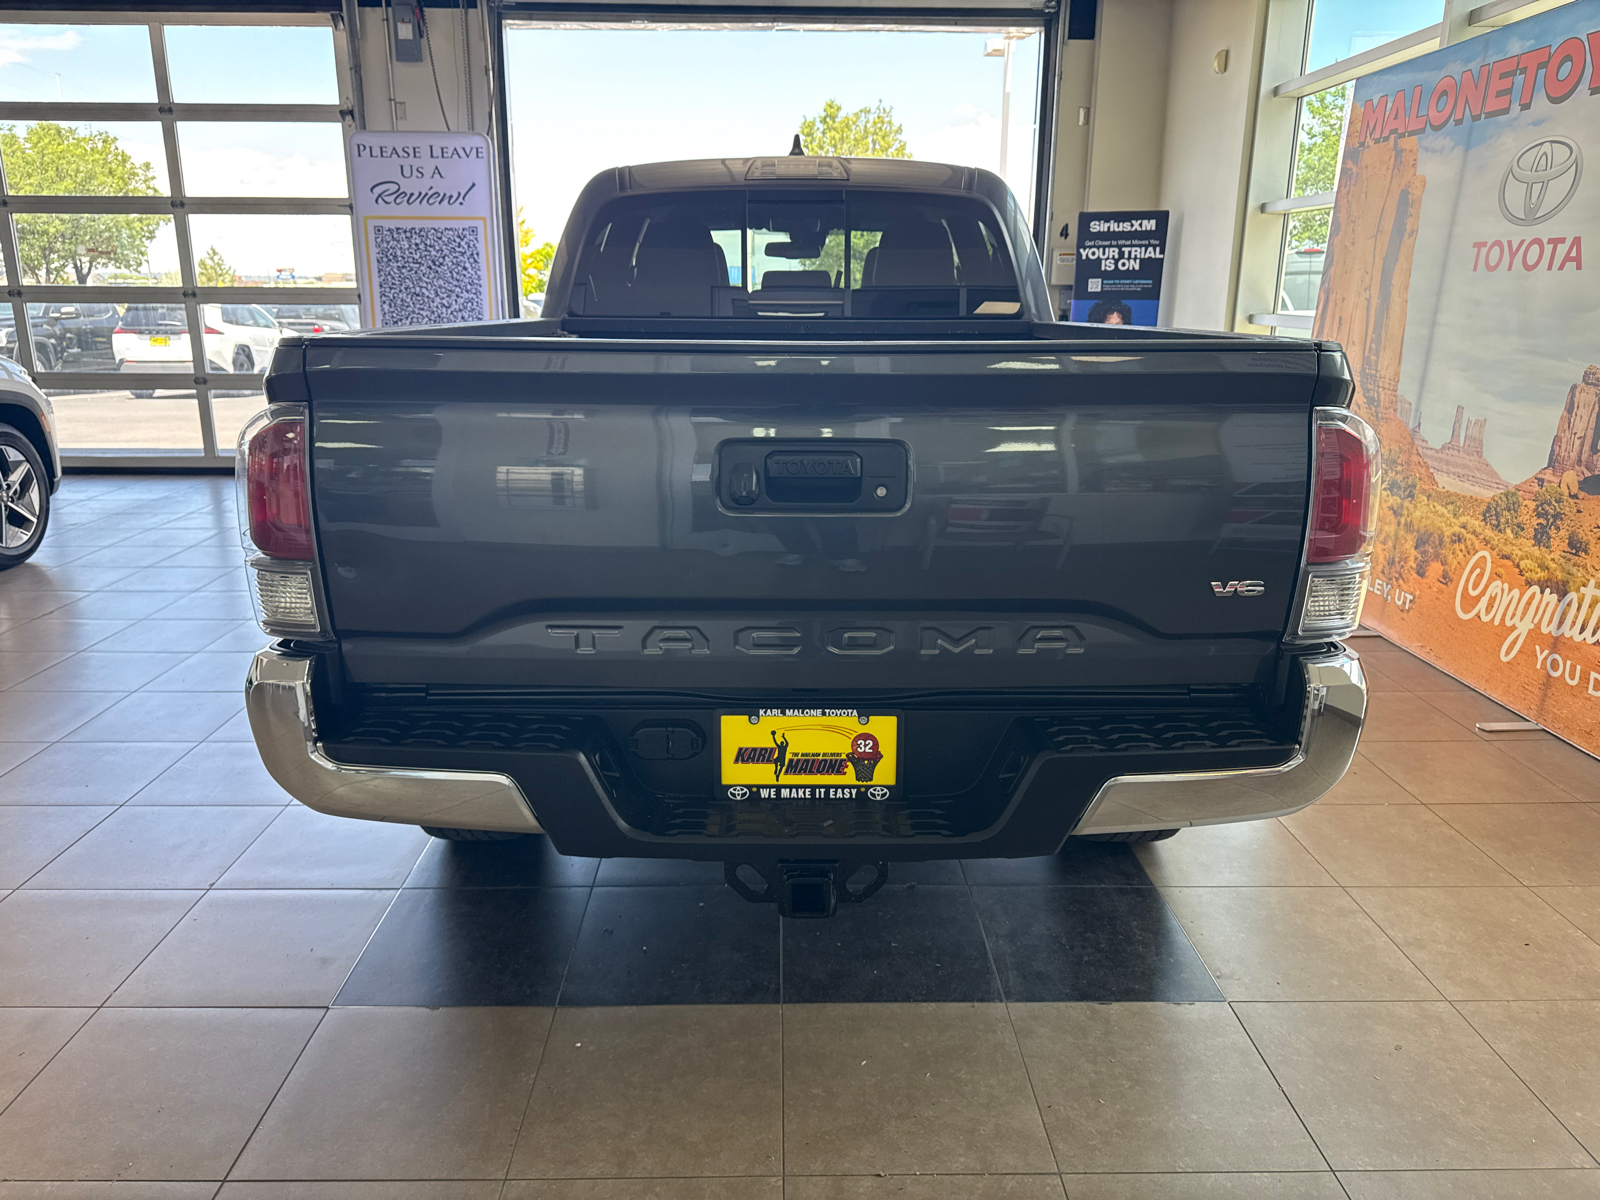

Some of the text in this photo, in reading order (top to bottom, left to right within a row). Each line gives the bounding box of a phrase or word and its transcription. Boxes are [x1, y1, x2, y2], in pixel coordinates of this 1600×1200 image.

[356, 143, 484, 159] PLEASE LEAVE
[430, 165, 445, 179] A
[370, 180, 476, 206] Review!
[1059, 223, 1069, 240] 4
[1089, 219, 1157, 233] SiriusXM
[1079, 247, 1119, 260] YOUR
[1121, 247, 1164, 259] TRIAL
[1472, 236, 1583, 272] TOYOTA
[1101, 259, 1140, 271] IS ON
[774, 460, 855, 475] TOYOTA
[1210, 580, 1265, 597] V6
[1394, 588, 1414, 610] UT
[545, 622, 1087, 656] TACOMA
[1534, 645, 1581, 686] YOU
[759, 709, 858, 717] KARL MALONE TOYOTA
[856, 739, 874, 753] 32
[733, 746, 777, 765] KARL
[783, 758, 849, 775] MALONE
[760, 788, 857, 799] WE MAKE IT EASY
